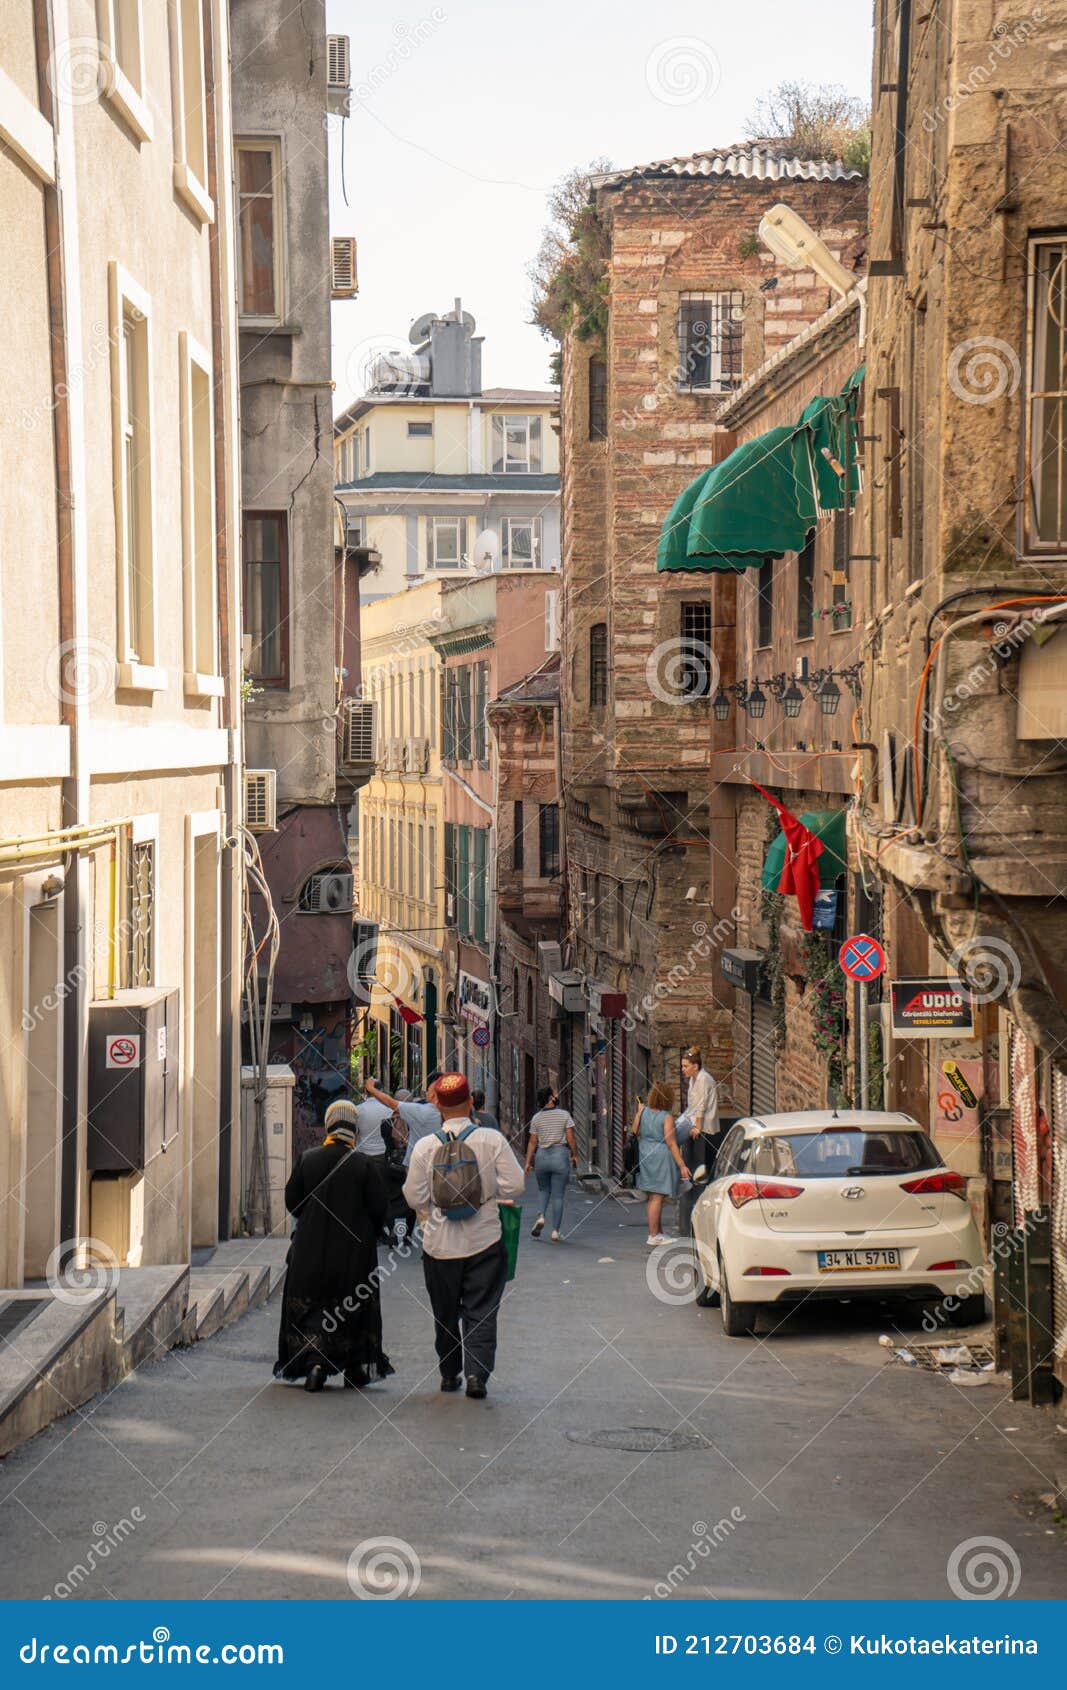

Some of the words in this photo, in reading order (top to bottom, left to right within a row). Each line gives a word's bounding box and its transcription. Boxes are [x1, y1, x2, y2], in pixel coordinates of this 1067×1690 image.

[904, 991, 963, 1010] AUDIO
[827, 1254, 840, 1266] 34
[846, 1253, 861, 1266] NL
[866, 1251, 895, 1265] 5718
